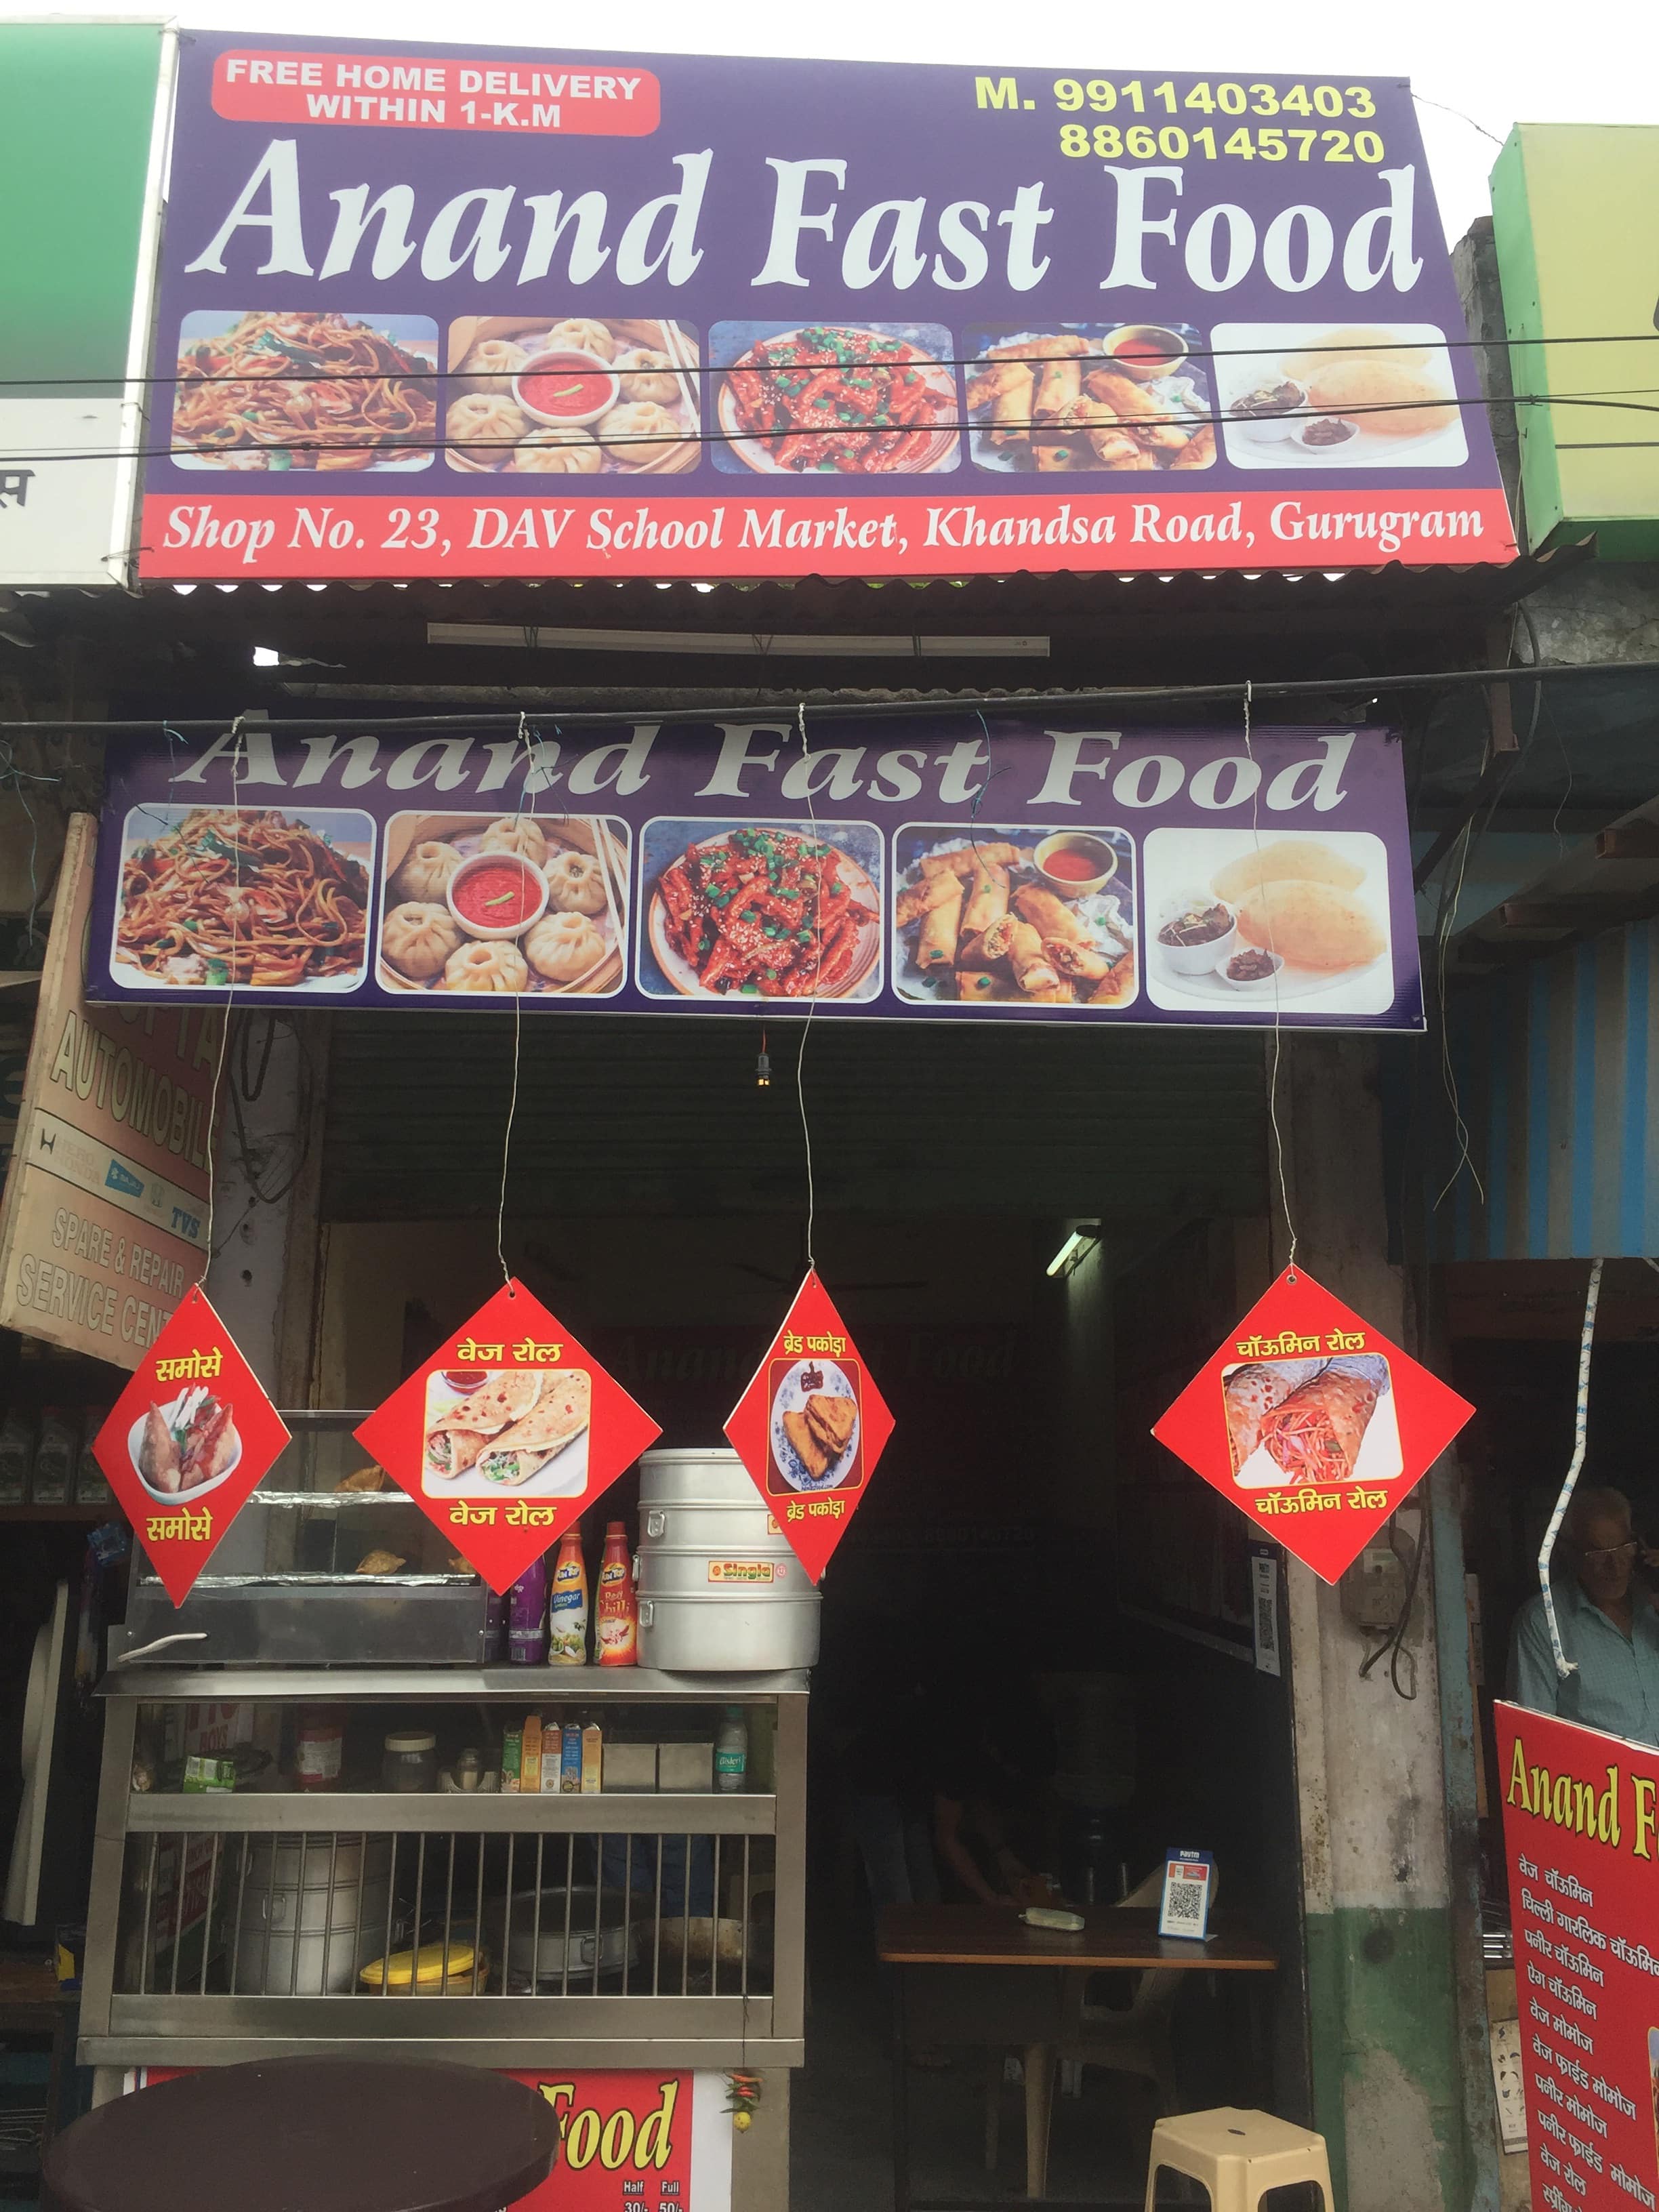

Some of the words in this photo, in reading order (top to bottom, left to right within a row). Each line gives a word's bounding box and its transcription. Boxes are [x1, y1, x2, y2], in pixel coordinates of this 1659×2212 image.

[226, 59, 322, 87] FREE
[335, 64, 445, 93] HOME
[459, 69, 640, 102] DELIVERY
[975, 77, 1036, 110] M.
[1054, 79, 1376, 119] 9911403403
[307, 94, 445, 125] WITHIN
[459, 100, 561, 129] 1-K.M
[1059, 124, 1385, 163] 8860145720
[184, 138, 714, 287] Anand
[751, 157, 1054, 293] Fast
[1099, 163, 1424, 293] Food
[163, 505, 274, 565] Shop
[288, 507, 365, 550] No.
[387, 508, 451, 557] 23,
[468, 508, 575, 550] DAV
[586, 506, 725, 551] School
[738, 507, 909, 556] Market,
[923, 503, 1116, 547] Khandsa
[1130, 501, 1256, 550] Road,
[1270, 501, 1484, 554] Gurugram
[169, 709, 663, 796] Anand
[694, 722, 990, 804] Fast
[1027, 729, 1356, 813] Food
[171, 1206, 201, 1240] TVS
[52, 1207, 113, 1268] SPARE
[114, 1236, 125, 1275] &
[129, 1242, 185, 1299] REPAIR
[16, 1253, 118, 1336] SERVICE
[457, 1338, 504, 1363] वेज
[512, 1336, 562, 1363] रोल
[783, 1329, 804, 1355] ब्रेड
[806, 1331, 846, 1358] पकोड़ा
[1235, 1330, 1321, 1359] चॉऊमिन
[1326, 1328, 1366, 1352] रोल
[155, 1347, 223, 1382] समोसे
[449, 1500, 495, 1526] वेज
[504, 1498, 556, 1526] रोल
[786, 1500, 806, 1523] ब्रेड
[808, 1497, 845, 1521] पकोड़ा
[1254, 1488, 1341, 1515] चॉऊमिन
[1348, 1486, 1389, 1510] रोल
[146, 1507, 213, 1542] समोसे
[723, 1563, 771, 1580] Singla
[554, 1593, 581, 1604] Vinegar
[1507, 1736, 1622, 1848] Anand
[1631, 1774, 1659, 1862] F
[1518, 1853, 1538, 1881] वेज
[1521, 1887, 1555, 1924] चिल्ली
[1556, 1916, 1607, 1950] गारलिक
[1524, 1929, 1553, 1959] पनीर
[1529, 1996, 1550, 2027] वेज
[1552, 2014, 1594, 2055] मोमोज
[1532, 2033, 1553, 2064] वेज
[1591, 2076, 1637, 2121] मोमोज
[1534, 2072, 1564, 2108] पनीर
[1565, 2095, 1608, 2139] मोमोज
[1538, 2109, 1566, 2145] पनीर
[1610, 2164, 1656, 2212] मोमोज
[1540, 2142, 1560, 2176] वेज
[1563, 2162, 1586, 2196] रोल
[623, 2181, 644, 2193] Half
[661, 2181, 680, 2193] Full
